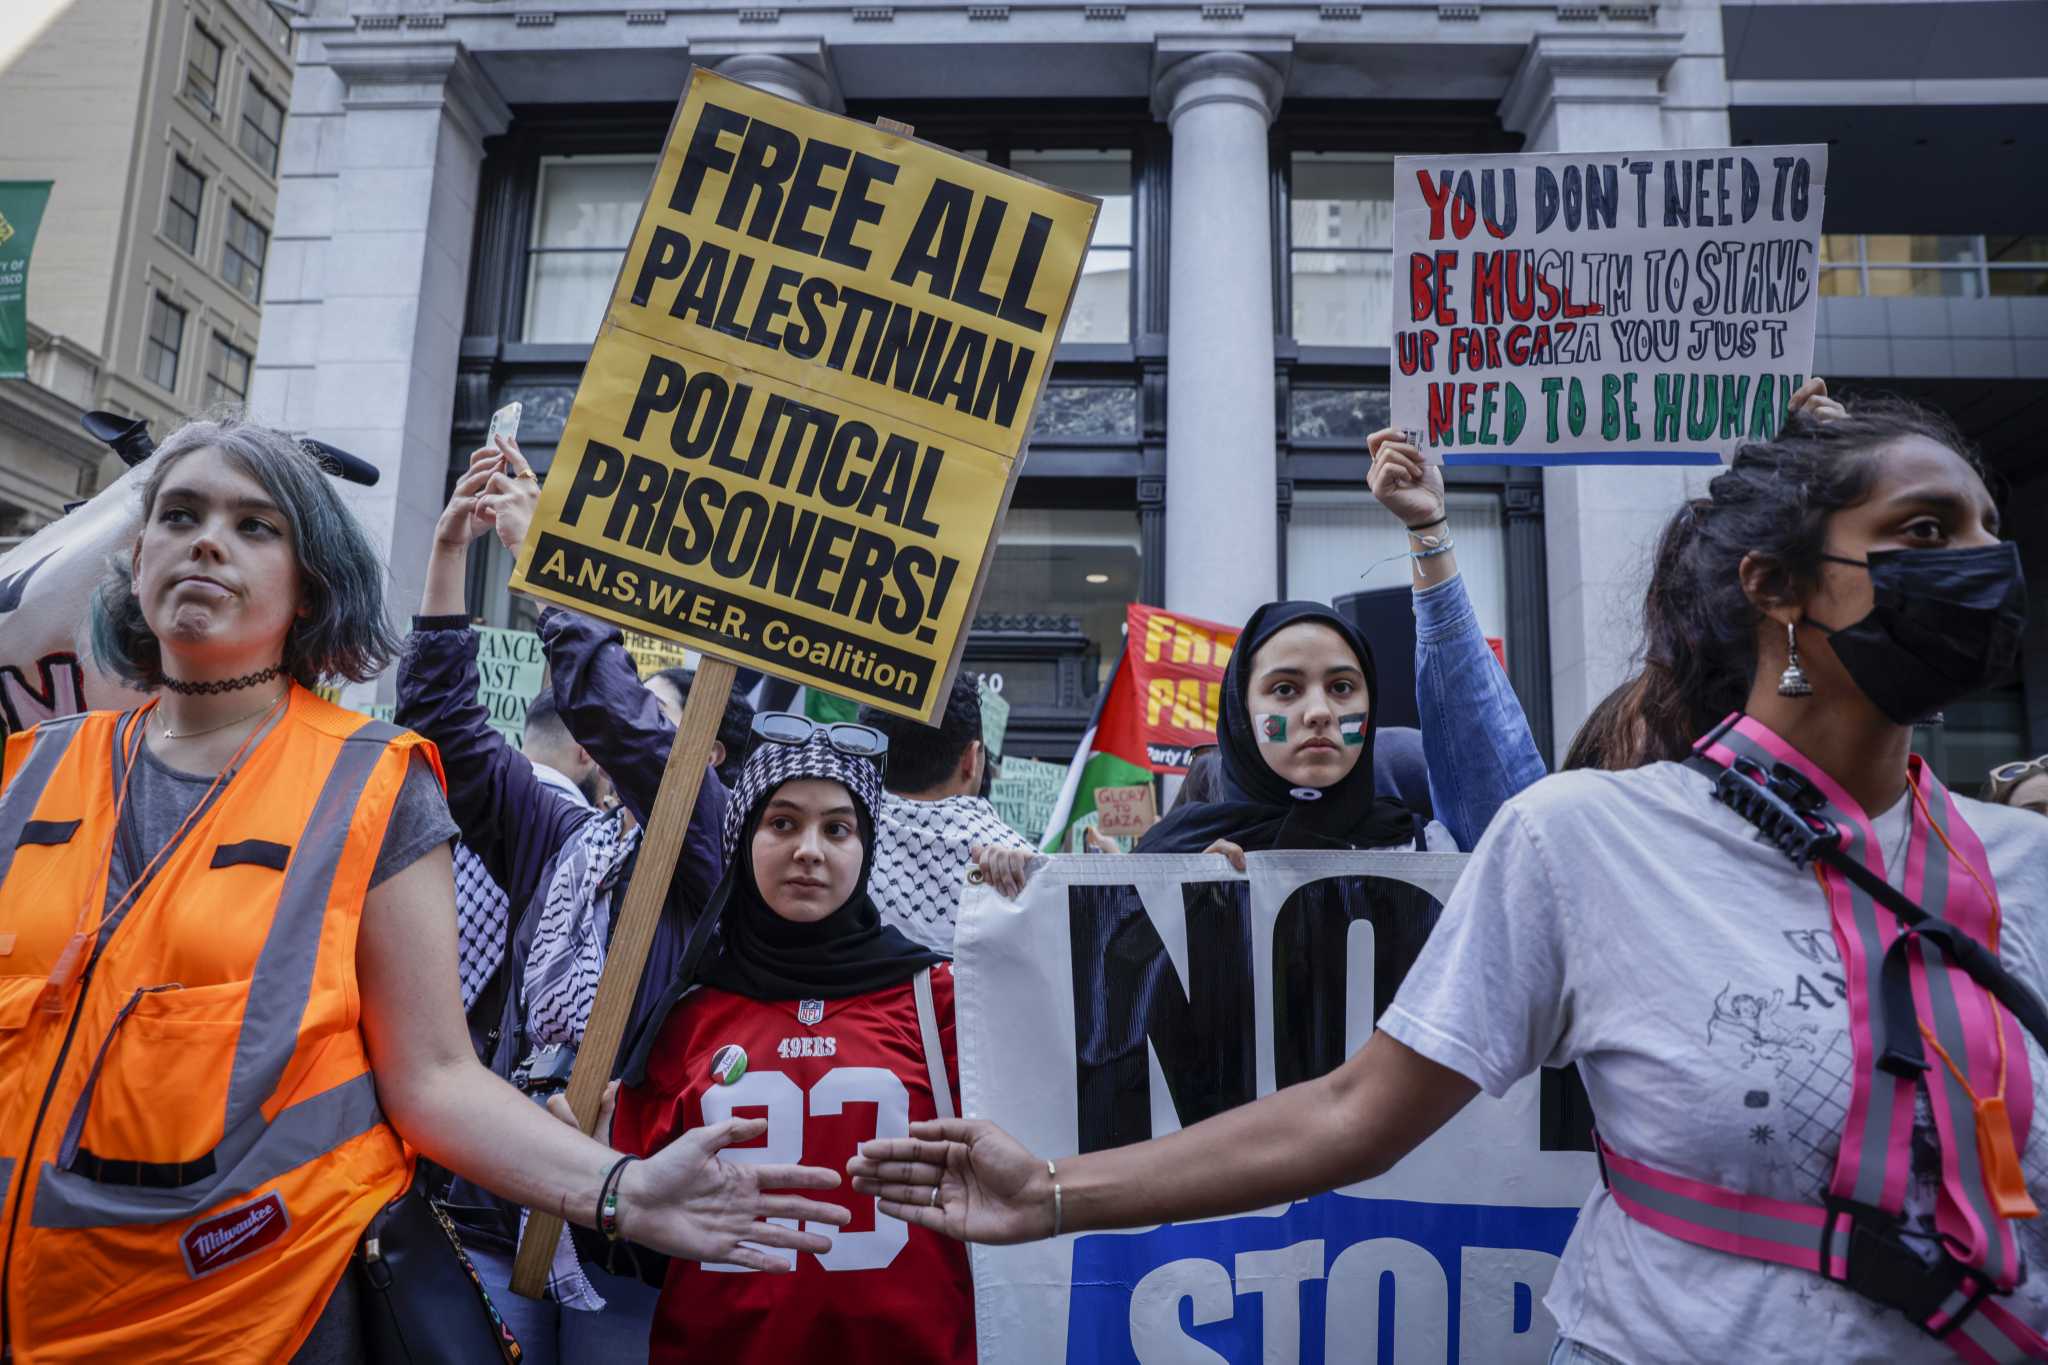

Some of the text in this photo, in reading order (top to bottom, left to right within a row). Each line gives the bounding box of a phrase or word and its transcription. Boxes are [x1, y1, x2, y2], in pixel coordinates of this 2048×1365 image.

[667, 101, 1054, 333] FREE ALL
[1415, 156, 1811, 240] YOU DON'T NEED TO
[1409, 239, 1814, 326] BE MUSLIM TO STAND
[630, 225, 1035, 429] PALESTINIAN
[1398, 320, 1787, 376] UP FOR GAZA YOU JUST
[622, 354, 945, 538] POLITICAL
[1427, 381, 1526, 448] NEED
[1541, 376, 1586, 443] TO
[1600, 373, 1641, 442] BE
[558, 438, 960, 643] PRISONERS!
[540, 548, 919, 696] A.N.S.W.E.R. Coalition
[777, 1036, 838, 1058] 49ERS
[801, 1009, 820, 1020] NFL
[192, 1204, 275, 1258] Milwaukee
